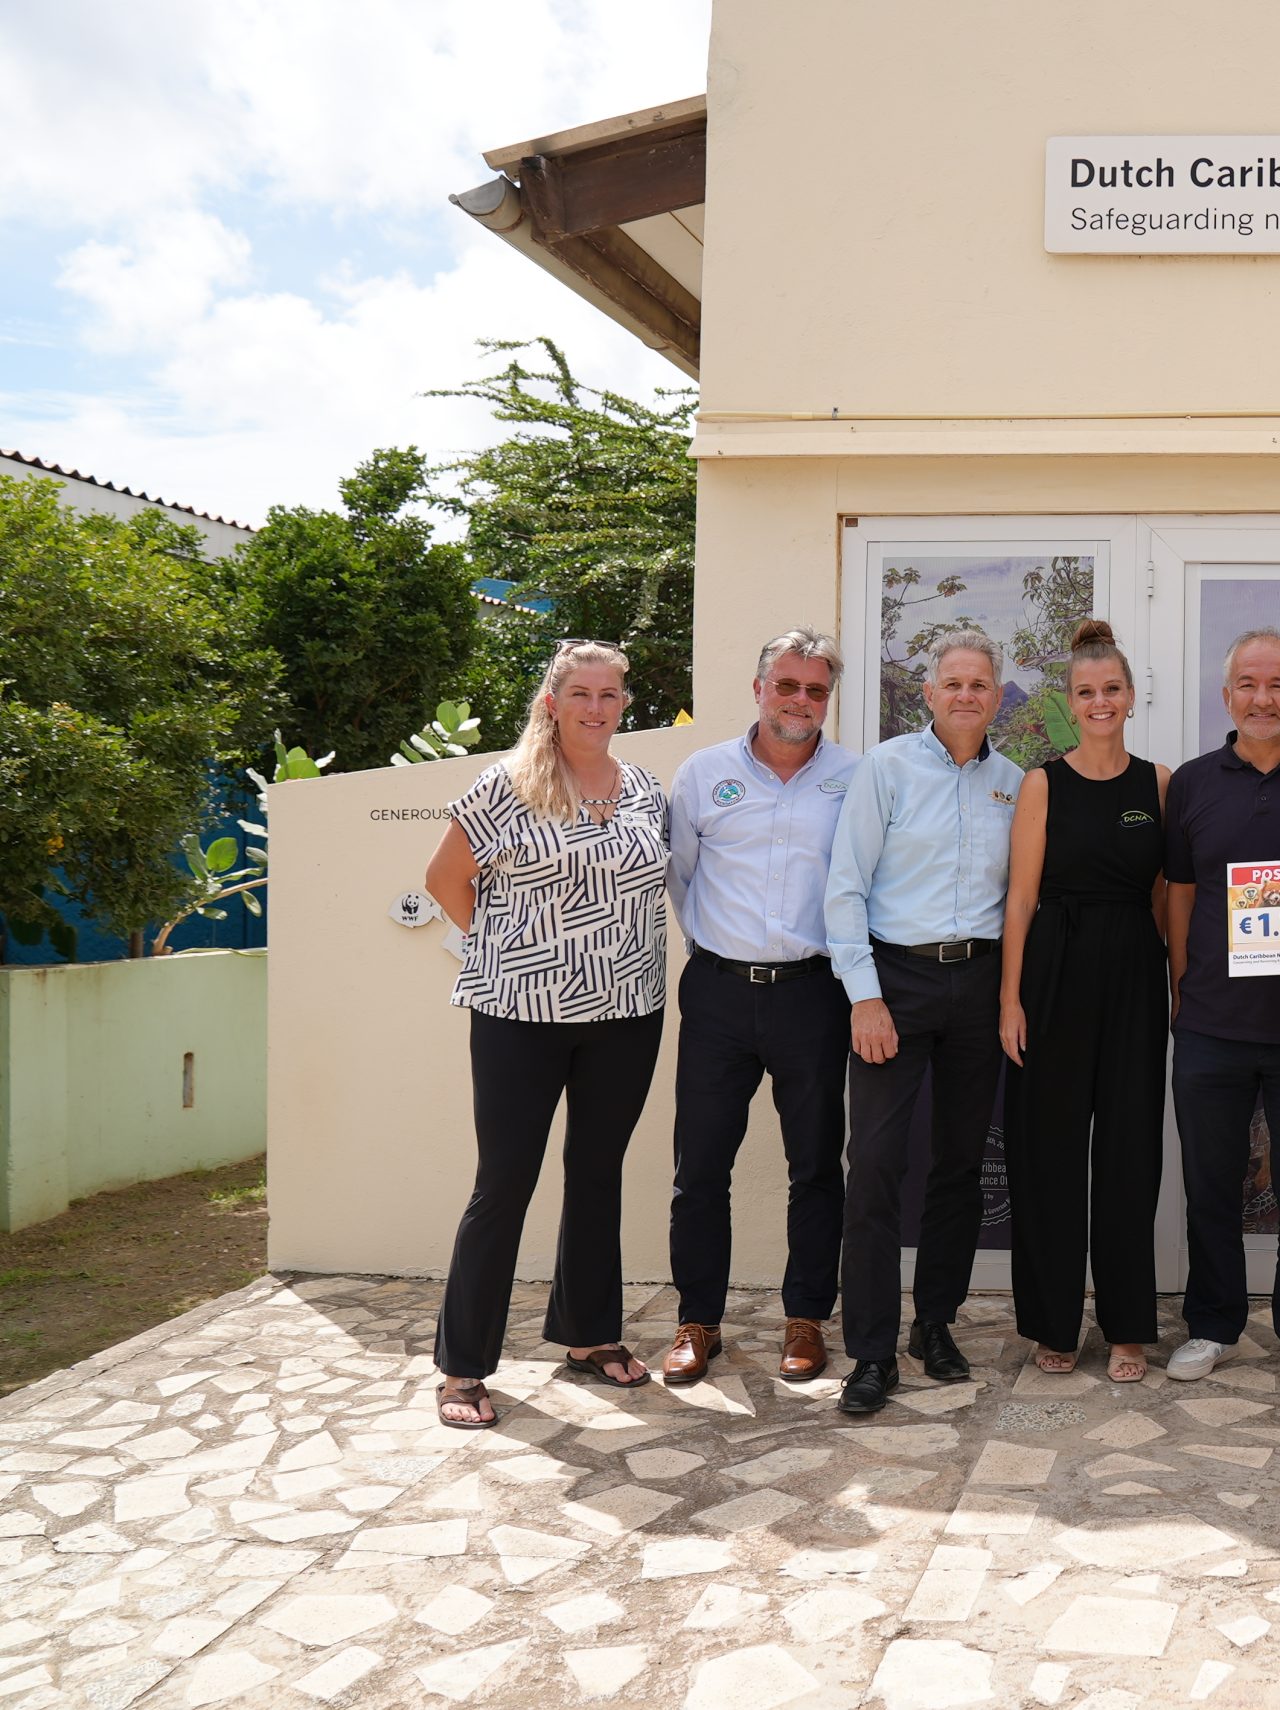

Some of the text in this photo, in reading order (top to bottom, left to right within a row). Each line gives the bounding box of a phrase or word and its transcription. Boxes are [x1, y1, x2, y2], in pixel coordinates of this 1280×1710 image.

[1071, 158, 1174, 188] Dutch
[1070, 207, 1254, 236] Safeguarding
[370, 808, 451, 821] GENEROUS
[1124, 814, 1148, 823] DCNA
[1239, 917, 1252, 935] €
[982, 1163, 1007, 1173] ribbea
[979, 1176, 999, 1185] ance
